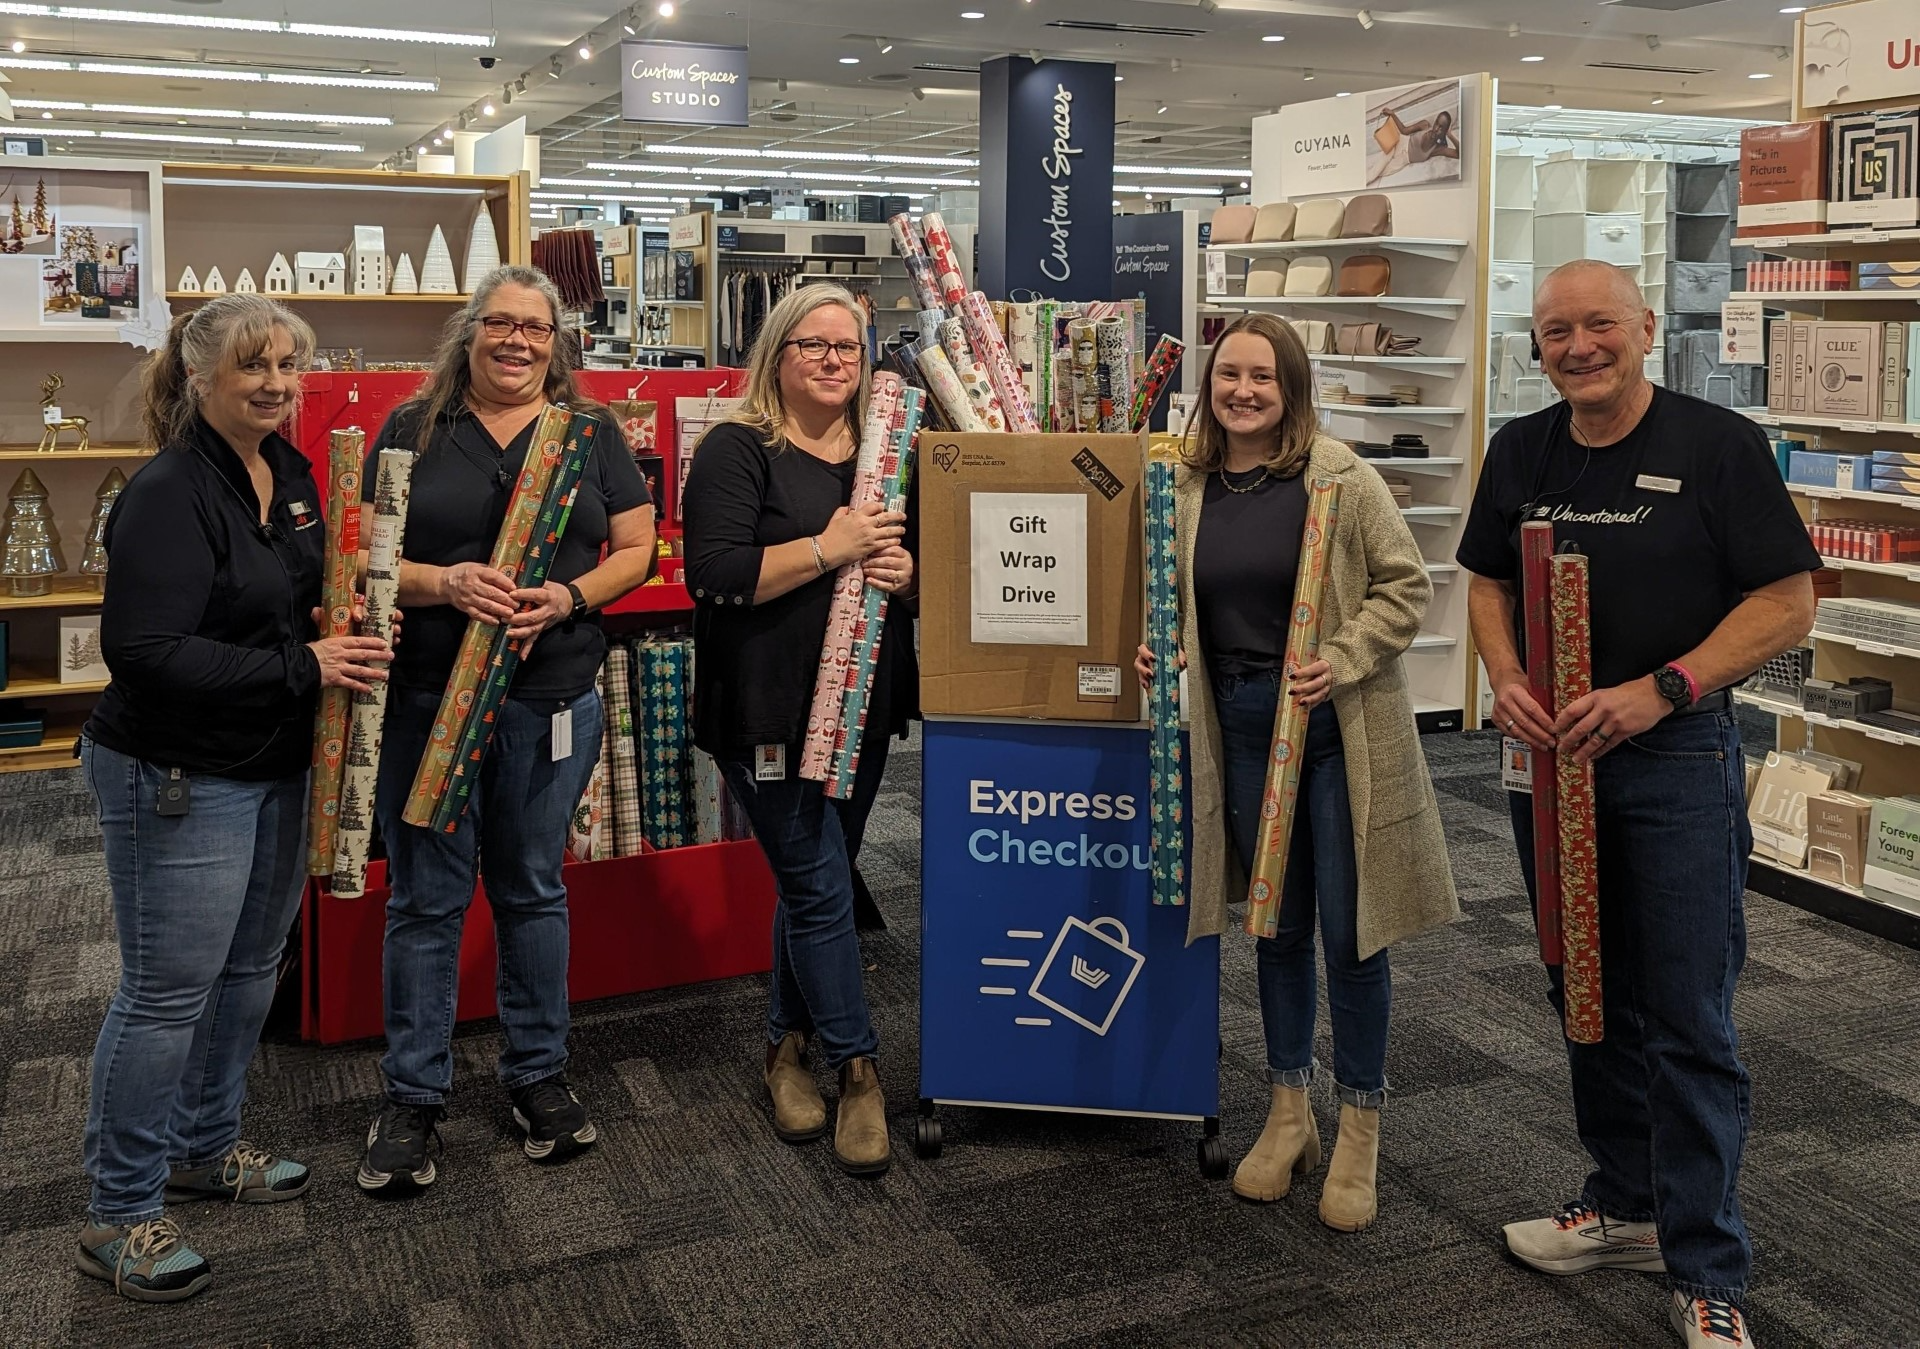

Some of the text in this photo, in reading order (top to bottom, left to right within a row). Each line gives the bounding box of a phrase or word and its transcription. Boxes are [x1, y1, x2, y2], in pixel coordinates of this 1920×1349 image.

[1887, 38, 1920, 70] U
[631, 59, 739, 90] Custom Spaces
[651, 91, 721, 107] STUDIO
[1294, 133, 1351, 154] CUYANA
[1770, 148, 1779, 159] in
[1040, 83, 1083, 281] Custom Spaces
[1750, 164, 1788, 177] Pictures
[1864, 160, 1883, 184] US
[1124, 245, 1133, 253] The
[1115, 255, 1170, 280] Custom Spaces
[1774, 353, 1783, 382] CLUE
[1794, 354, 1803, 383] CLUE
[1887, 356, 1896, 387] CLUE
[932, 452, 951, 466] IRIS
[1075, 451, 1120, 498] FRAGILE
[1009, 515, 1047, 534] Gift
[1552, 503, 1652, 524] Uncontained!
[1000, 551, 1057, 573] Wrap
[1002, 585, 1056, 604] Drive
[969, 779, 1136, 825] Express
[1822, 810, 1844, 825] Little
[1815, 824, 1852, 841] Moments
[968, 828, 1152, 871] Checkou
[1878, 836, 1915, 862] Young
